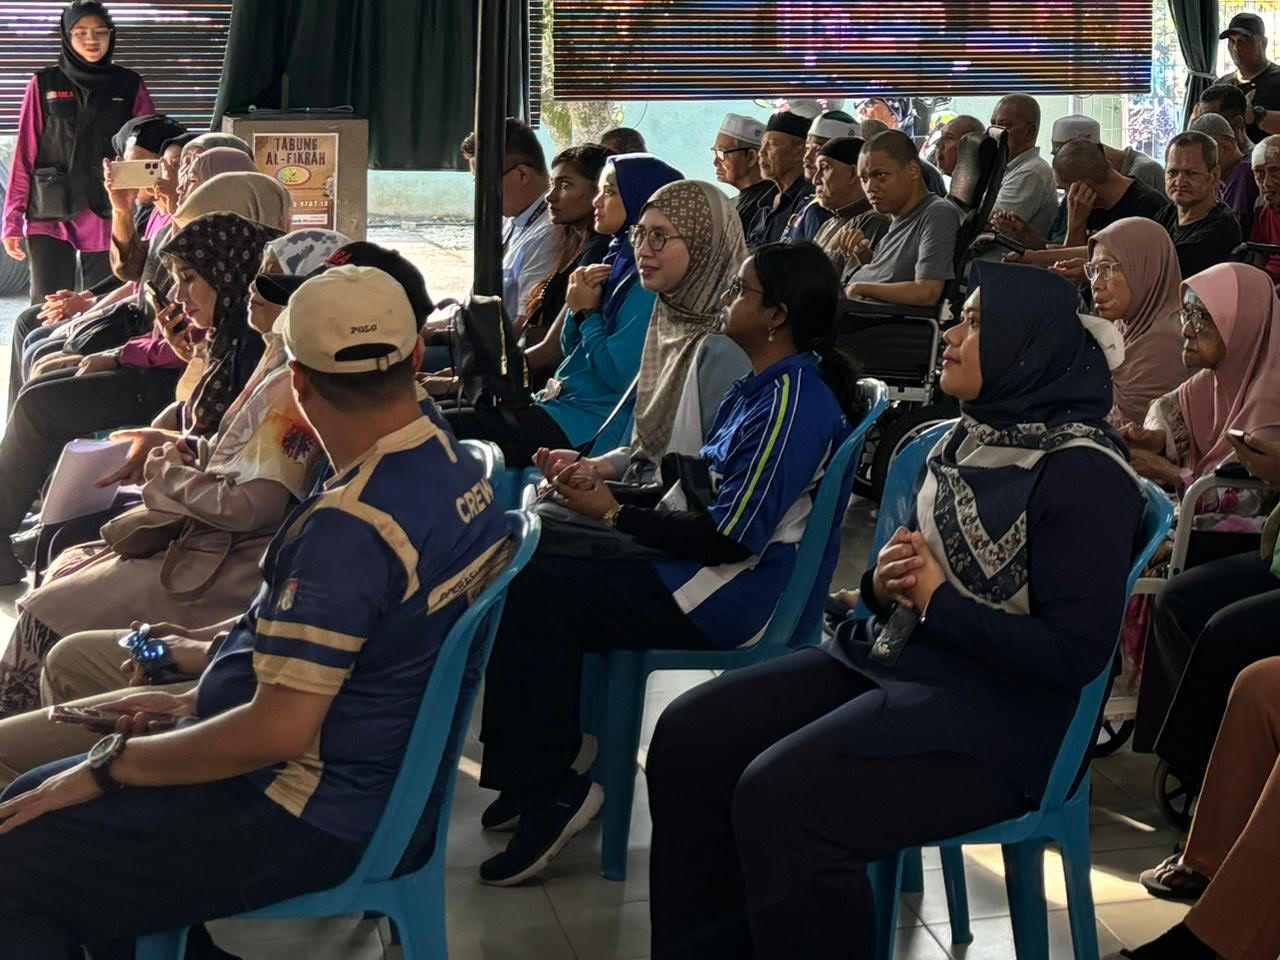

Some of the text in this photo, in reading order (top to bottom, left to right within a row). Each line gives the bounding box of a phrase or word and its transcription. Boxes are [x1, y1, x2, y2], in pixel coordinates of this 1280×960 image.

[275, 137, 318, 151] TABUNG
[266, 152, 326, 166] AL-FIKRAH
[350, 324, 377, 334] POLO
[456, 478, 494, 524] CREW
